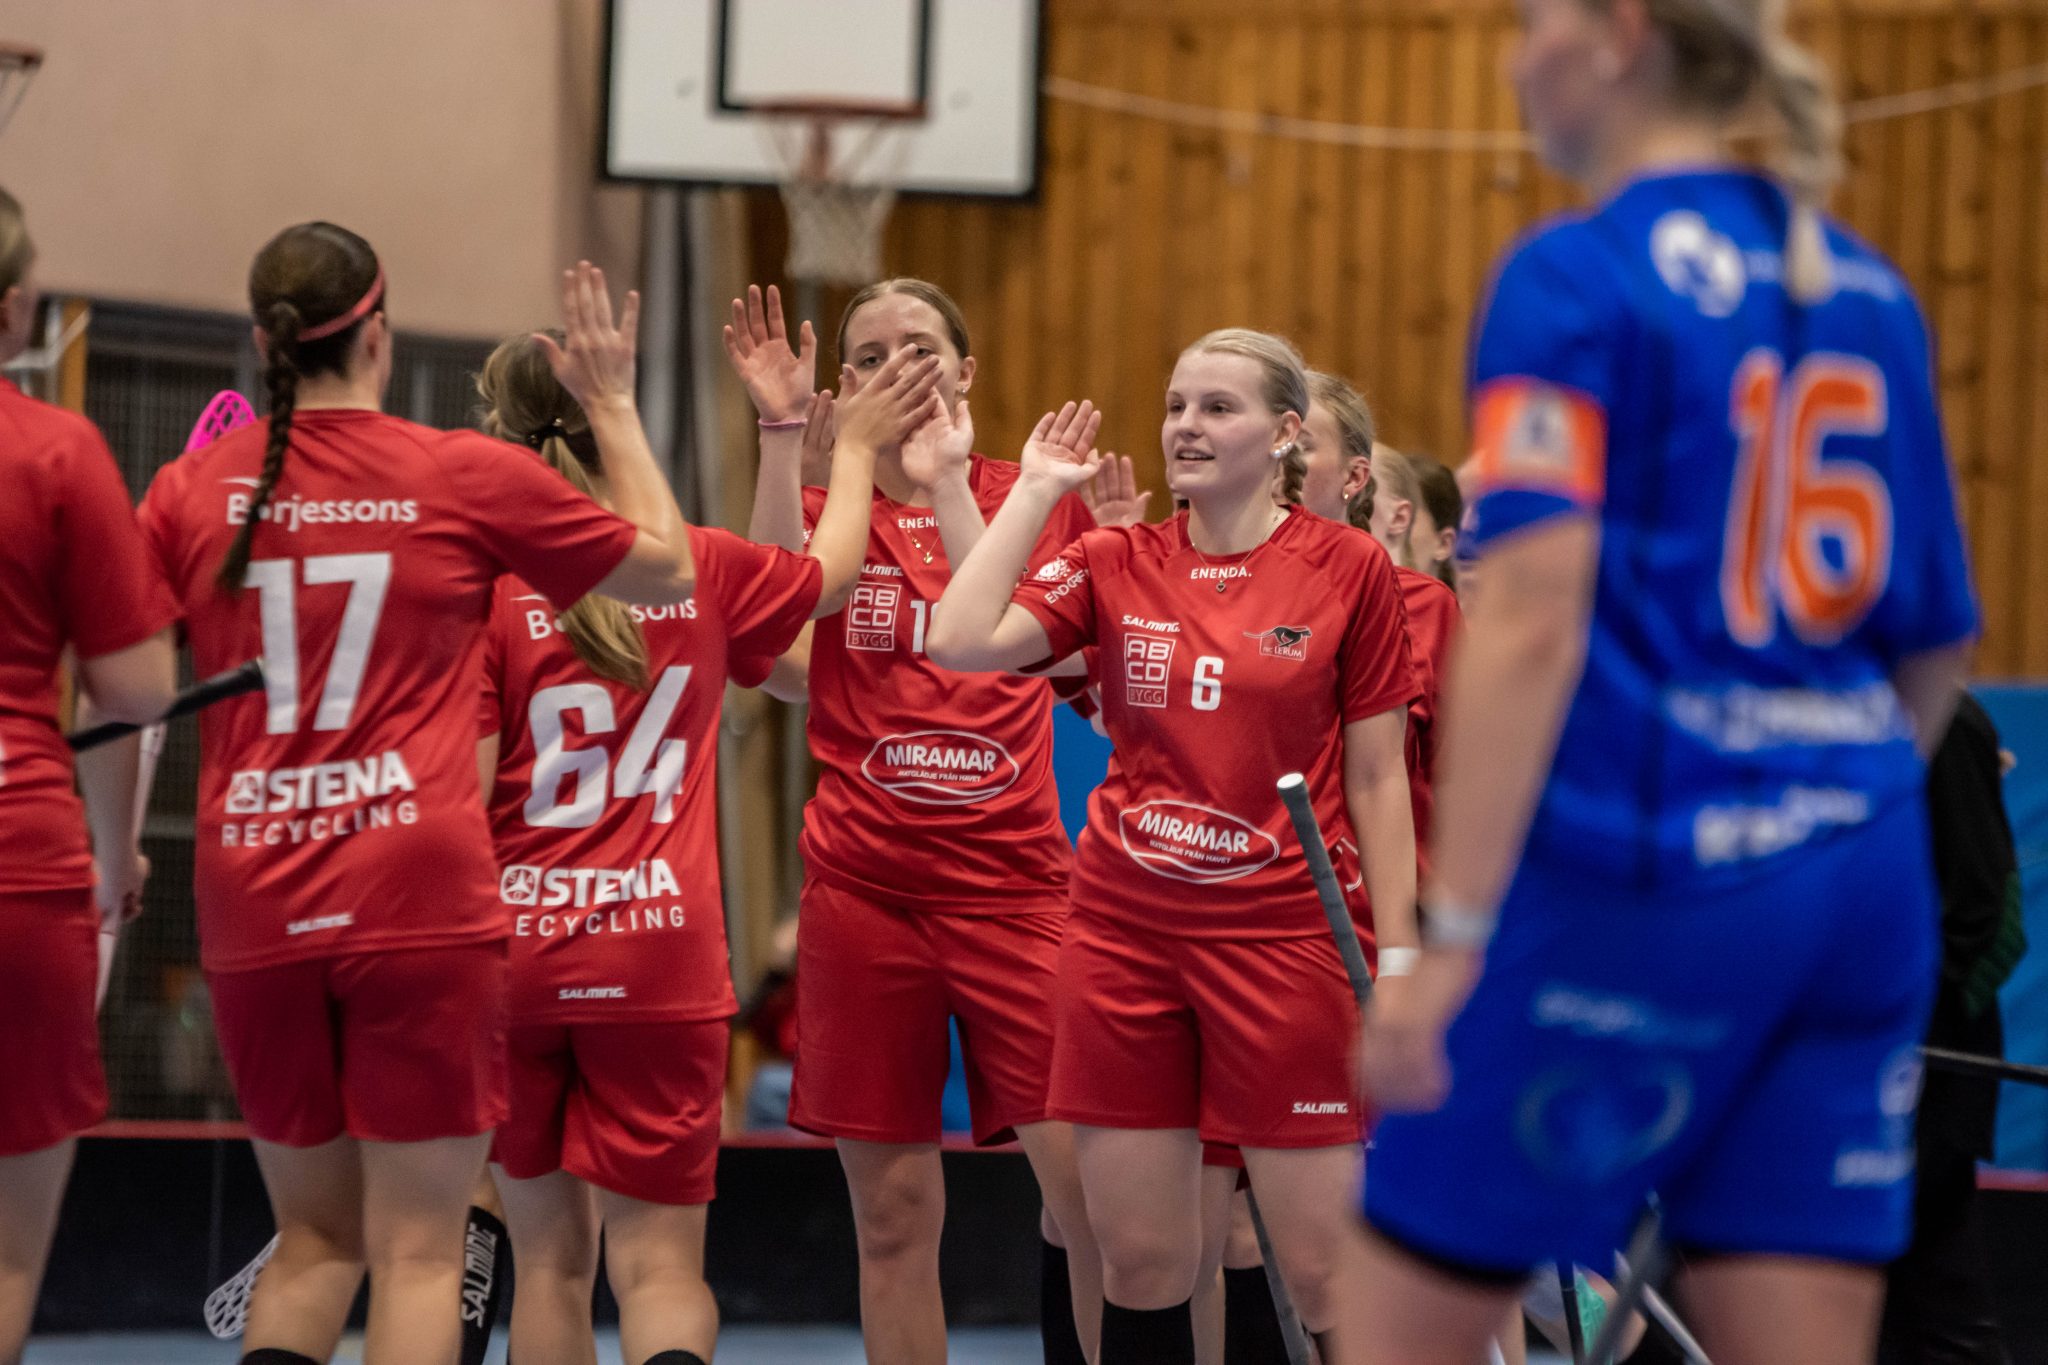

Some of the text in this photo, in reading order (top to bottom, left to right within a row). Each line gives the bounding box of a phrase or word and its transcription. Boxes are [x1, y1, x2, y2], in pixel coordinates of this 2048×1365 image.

[1720, 347, 1893, 648] 16
[898, 516, 939, 528] ENEN
[242, 552, 392, 735] 17
[851, 634, 889, 647] BYGG
[910, 600, 940, 653] 1
[1129, 687, 1162, 703] BYGG
[1191, 656, 1224, 712] 6
[523, 665, 692, 828] 64
[885, 745, 997, 772] MIRAMAR
[267, 751, 416, 813] STENA
[222, 801, 418, 847] RECYCLING
[1137, 810, 1250, 854] MIRAMAR
[541, 859, 682, 908] STENA
[515, 905, 685, 937] ECYCLING
